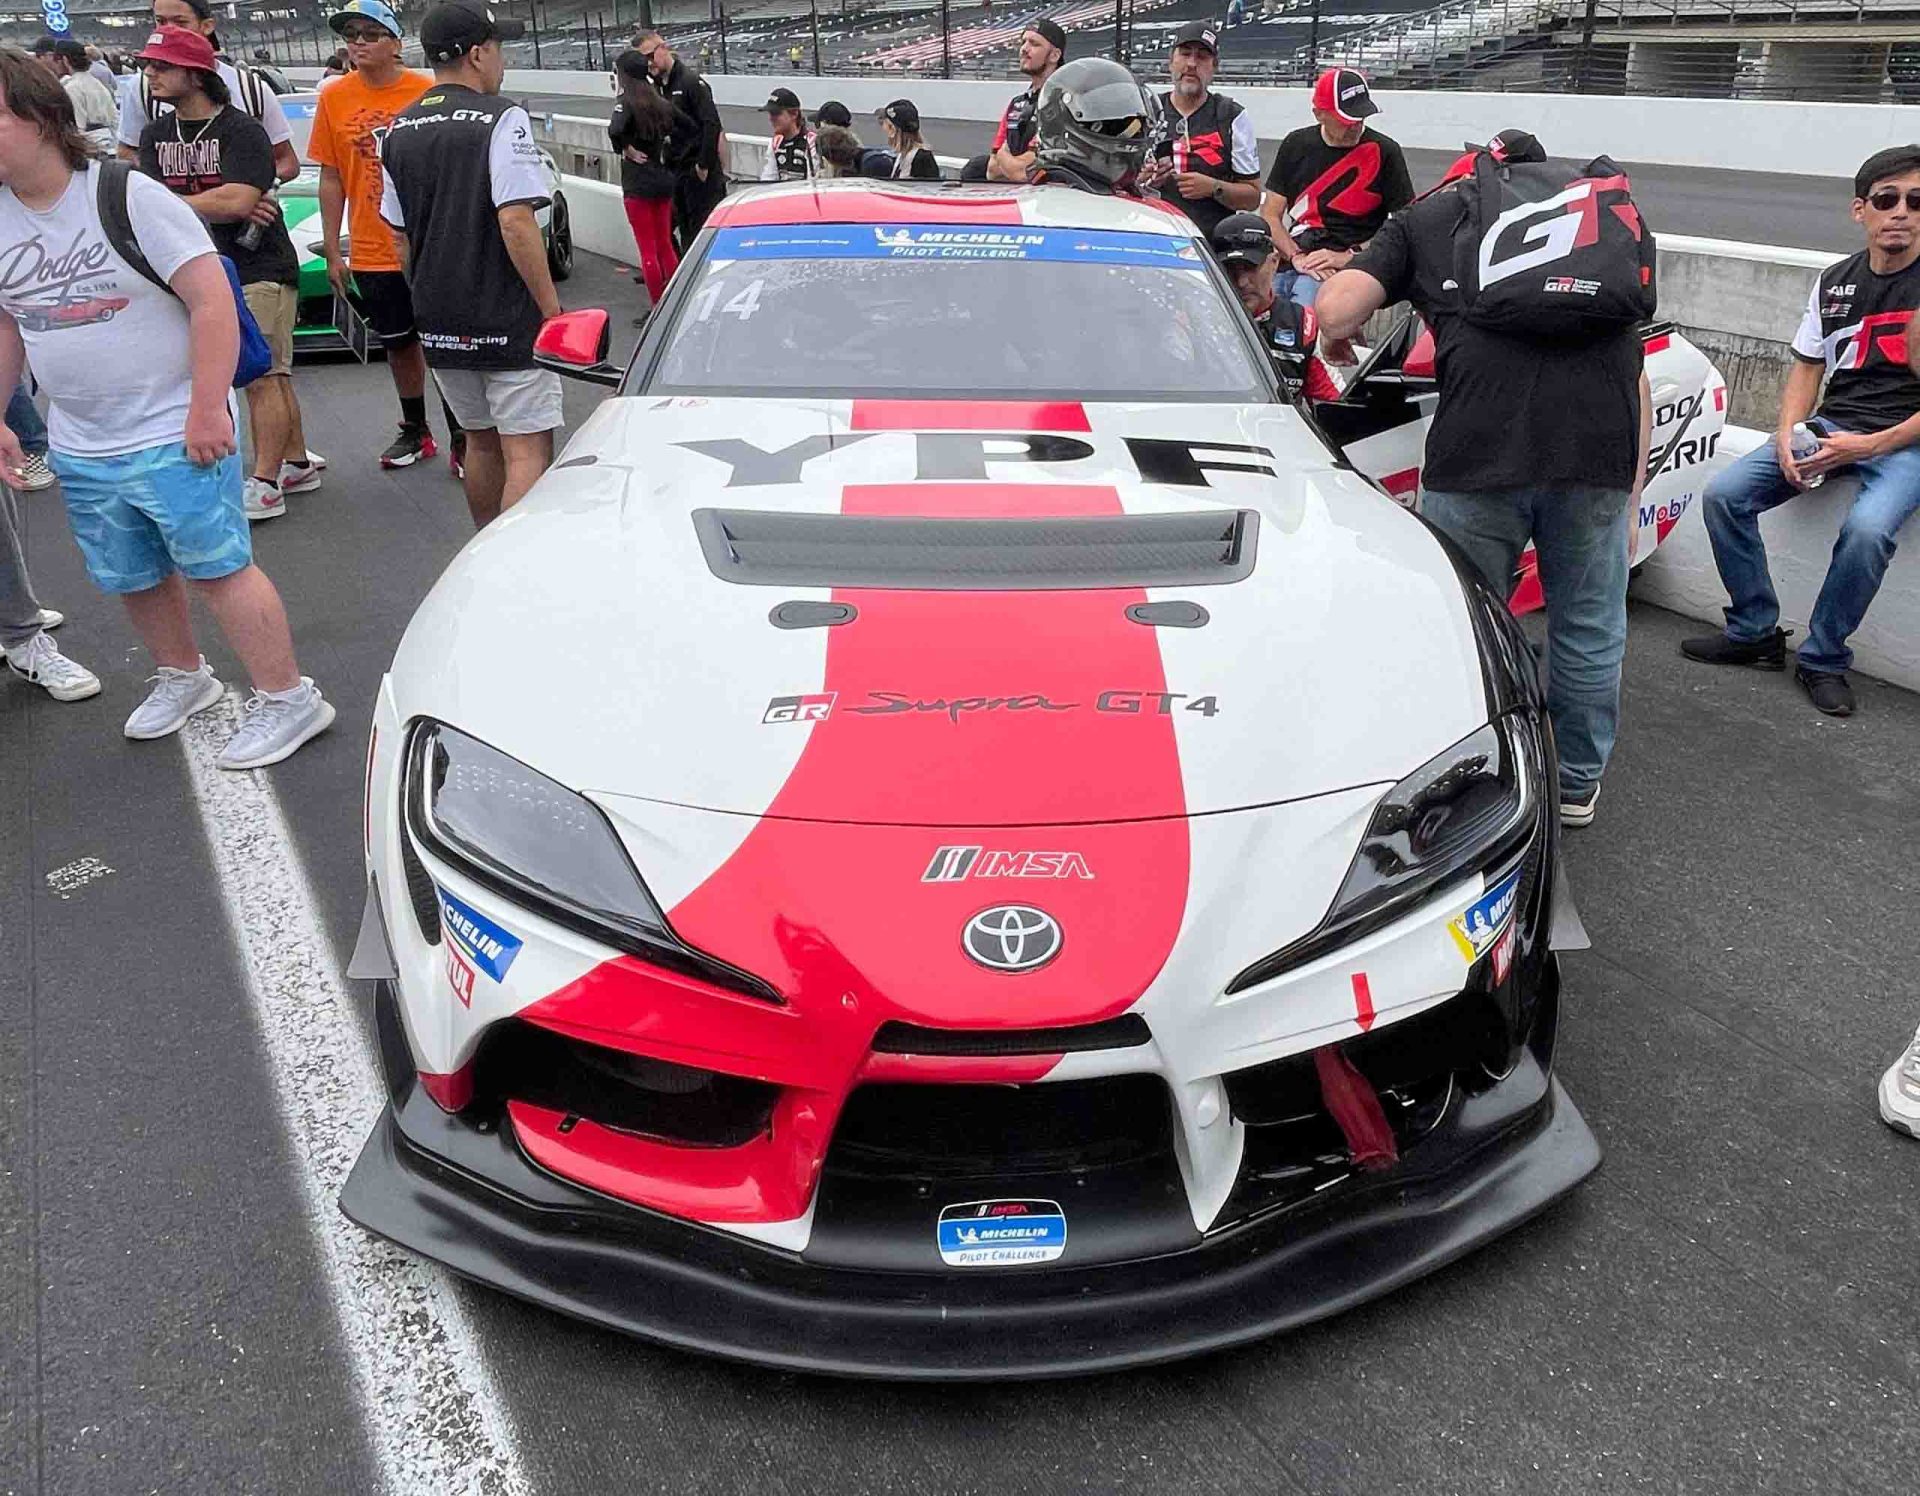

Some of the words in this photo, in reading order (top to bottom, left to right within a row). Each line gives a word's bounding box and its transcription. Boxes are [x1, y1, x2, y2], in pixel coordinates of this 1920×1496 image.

[394, 114, 449, 131] Supra
[452, 109, 494, 124] GT4
[917, 232, 1045, 246] MICHELIN
[0, 228, 110, 305] Dodge
[694, 279, 764, 322] 14
[666, 432, 1279, 488] YPF
[762, 692, 838, 724] GR
[843, 692, 1081, 725] Supra
[1095, 690, 1221, 718] GT4
[974, 851, 1096, 880] IMSA
[979, 1227, 1049, 1240] MICHELIN
